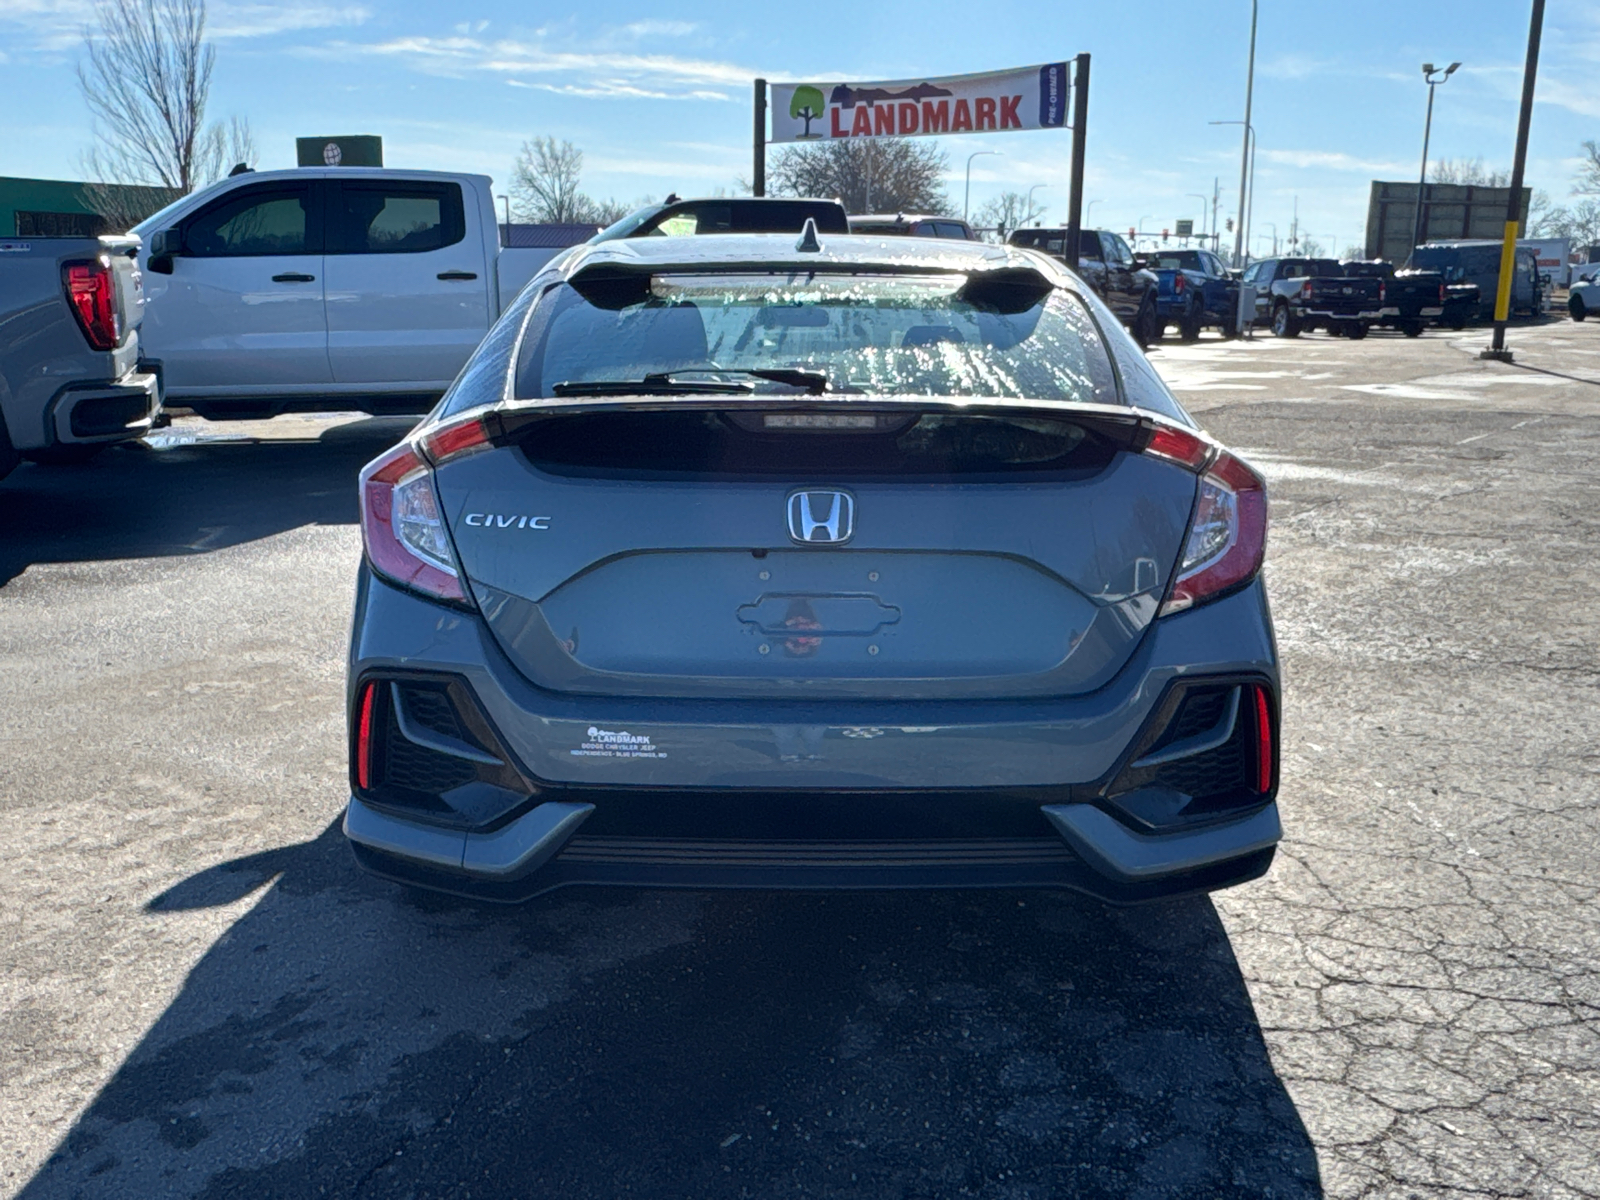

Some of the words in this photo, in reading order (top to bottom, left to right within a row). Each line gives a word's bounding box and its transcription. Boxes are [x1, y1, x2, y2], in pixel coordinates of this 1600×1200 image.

[1048, 67, 1058, 125] PRE-OWNED
[830, 94, 1023, 138] LANDMARK
[465, 513, 552, 530] CIVIC
[597, 735, 651, 745] LANDMARK
[605, 743, 639, 751] CHRYSLER
